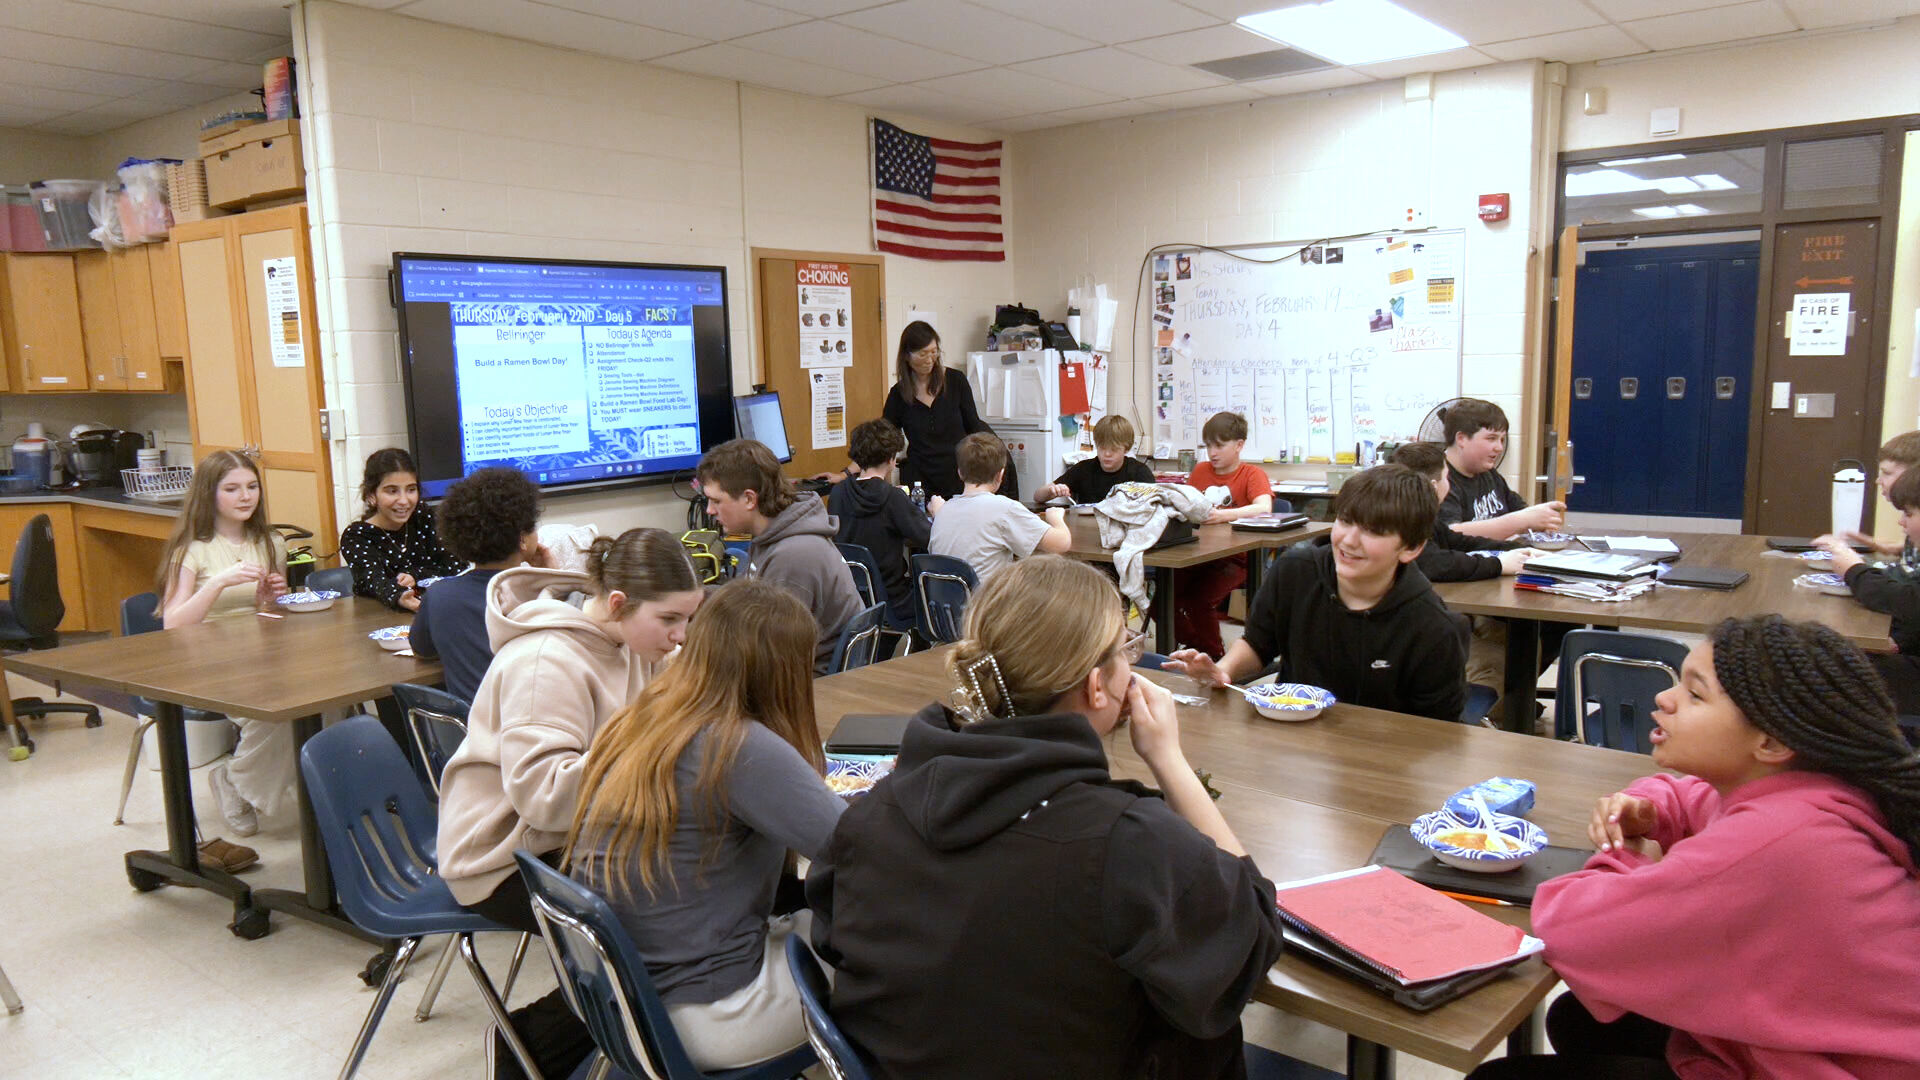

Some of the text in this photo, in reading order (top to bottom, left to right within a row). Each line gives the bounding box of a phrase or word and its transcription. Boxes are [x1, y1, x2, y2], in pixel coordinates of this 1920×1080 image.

[1804, 235, 1845, 248] FIRE
[1802, 249, 1843, 261] EXIT
[798, 268, 849, 285] CHOKING
[454, 308, 512, 324] THURSDAY,
[515, 309, 568, 325] February
[570, 310, 595, 323] 22ND
[606, 311, 624, 326] Day
[627, 311, 633, 323] 5
[645, 308, 677, 321] FACS 7
[1181, 298, 1250, 323] THURSDAY,
[1800, 305, 1839, 316] FIRE
[497, 328, 546, 344] Bellringer
[607, 328, 672, 343] Today's Agenda
[1268, 318, 1281, 339] 4
[475, 359, 495, 367] Build
[532, 358, 550, 366] Bowl
[552, 357, 568, 367] Day!
[484, 403, 568, 420] Today's Objective
